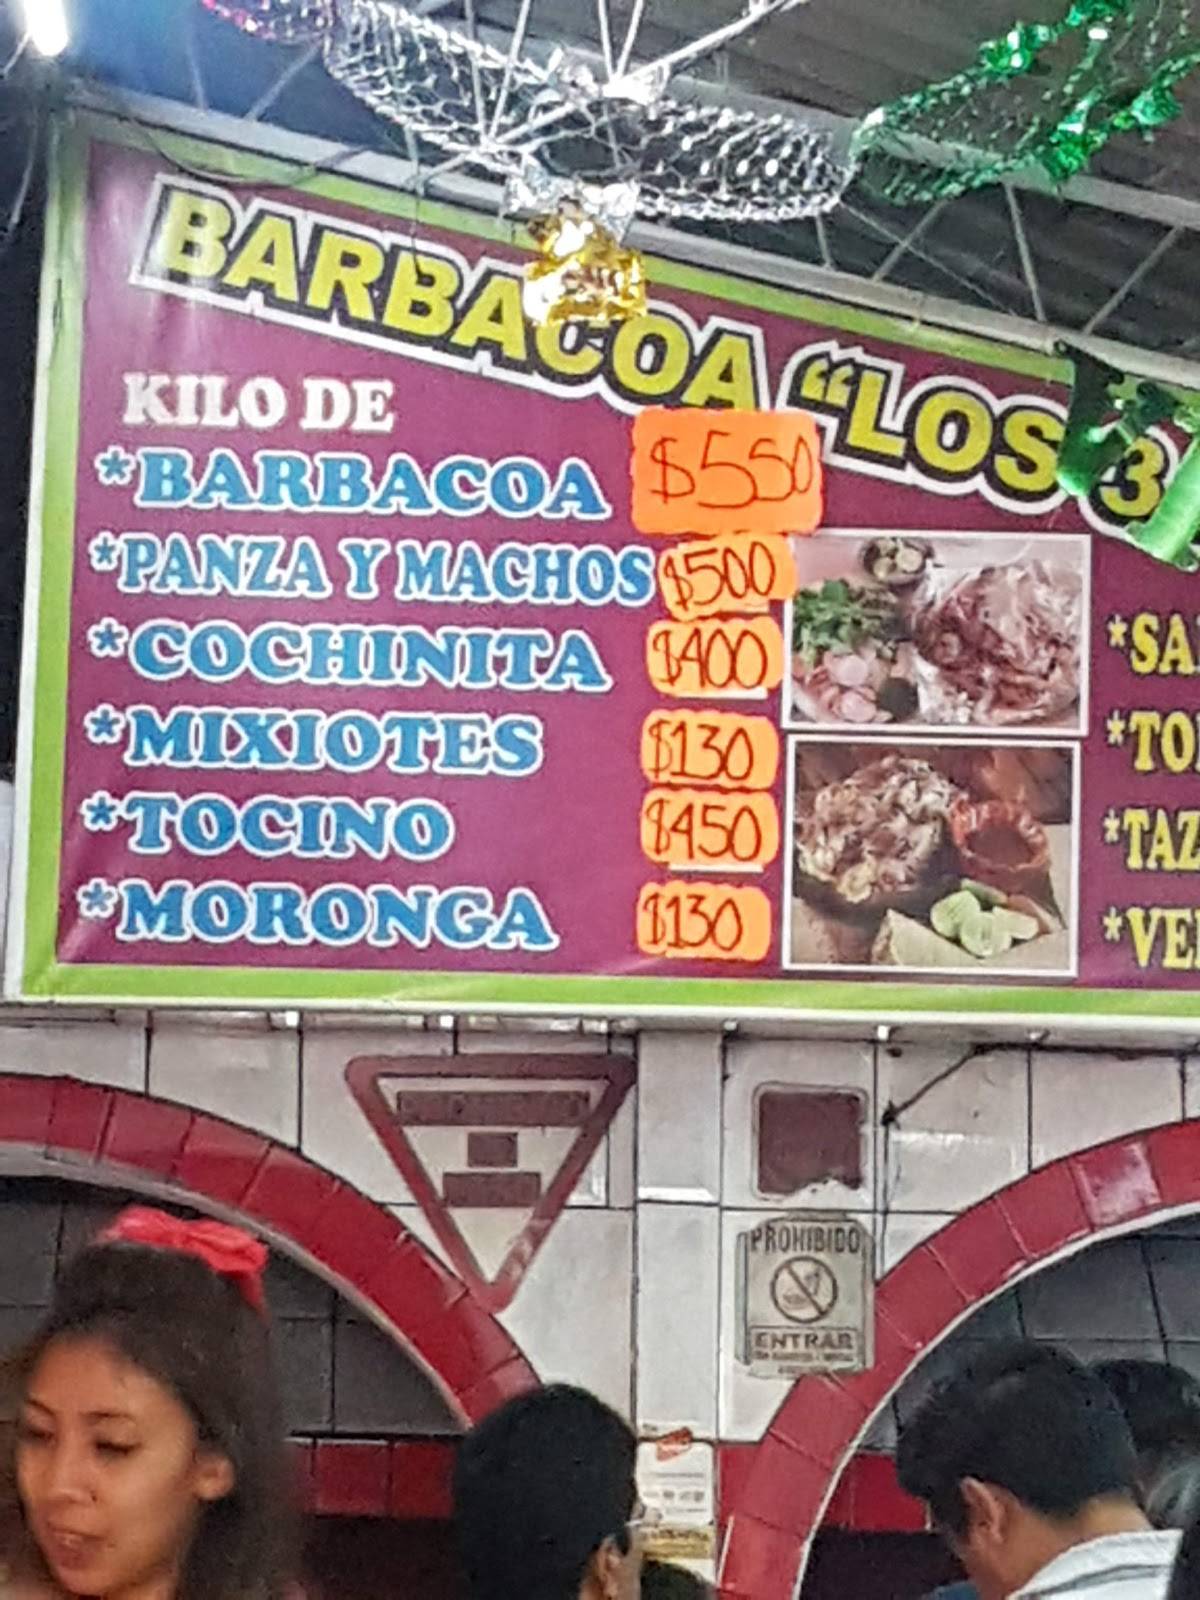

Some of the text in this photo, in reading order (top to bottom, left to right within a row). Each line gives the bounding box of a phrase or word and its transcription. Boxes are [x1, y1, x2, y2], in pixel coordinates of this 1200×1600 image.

[154, 188, 762, 412] BARBACOA
[1099, 433, 1165, 522] 3
[123, 373, 395, 433] KILO DE
[134, 449, 612, 521] BARBACOA
[649, 430, 813, 509] $550
[117, 533, 656, 607] PANZA Y MACHOS
[663, 541, 776, 611] $500
[129, 618, 612, 693] COCHINITA
[651, 627, 768, 688] $400
[1130, 612, 1200, 675] SA
[123, 706, 543, 776] MIXIOTES
[648, 718, 754, 781] $130
[1128, 710, 1200, 774] TO
[126, 794, 455, 862] TOCINO
[646, 797, 761, 863] $450
[115, 880, 559, 952] MORONGA
[642, 891, 743, 951] $130
[1124, 905, 1200, 970] VE
[751, 1224, 861, 1255] PROHIBIDO
[754, 1331, 854, 1350] ENTRAR
